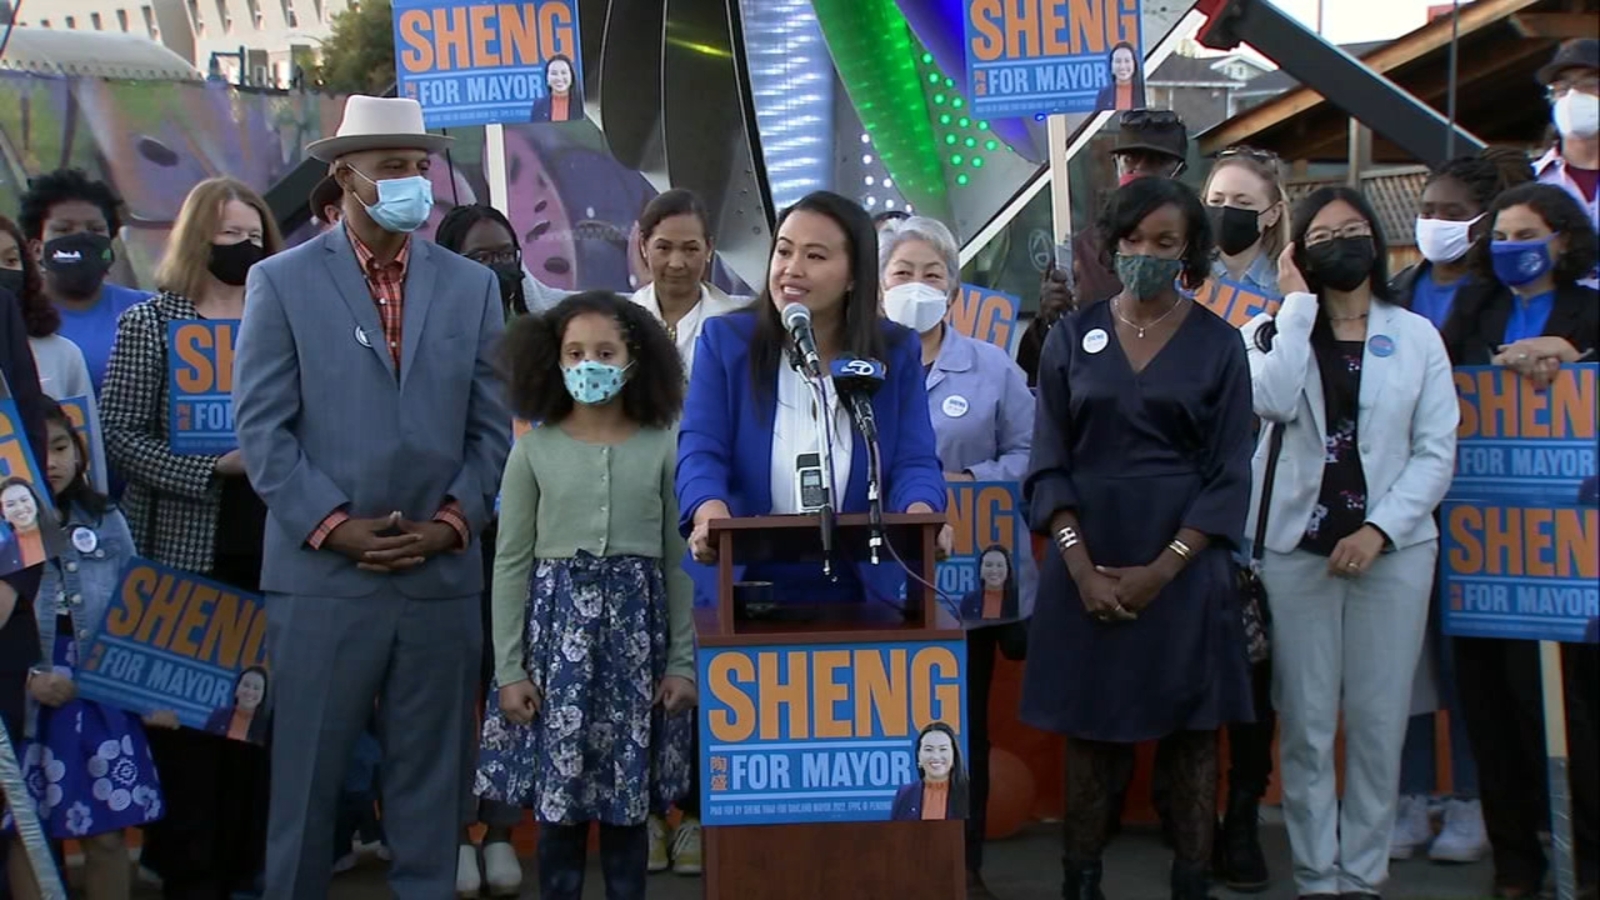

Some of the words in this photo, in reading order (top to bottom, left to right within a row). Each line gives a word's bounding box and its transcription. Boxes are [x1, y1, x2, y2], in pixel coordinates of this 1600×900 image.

[400, 2, 575, 72] SHENG
[970, 0, 1138, 60] SHENG
[419, 79, 460, 105] FOR
[467, 74, 543, 102] MAYOR
[989, 68, 1028, 95] FOR
[1035, 62, 1108, 92] MAYOR
[1460, 449, 1505, 475] FOR
[1511, 449, 1595, 476] MAYOR
[1465, 584, 1510, 612] FOR
[1517, 585, 1600, 616] MAYOR
[100, 647, 146, 681] FOR
[146, 659, 232, 706] MAYOR
[707, 646, 960, 742] SHENG
[732, 754, 790, 790] FOR
[802, 750, 911, 788] MAYOR
